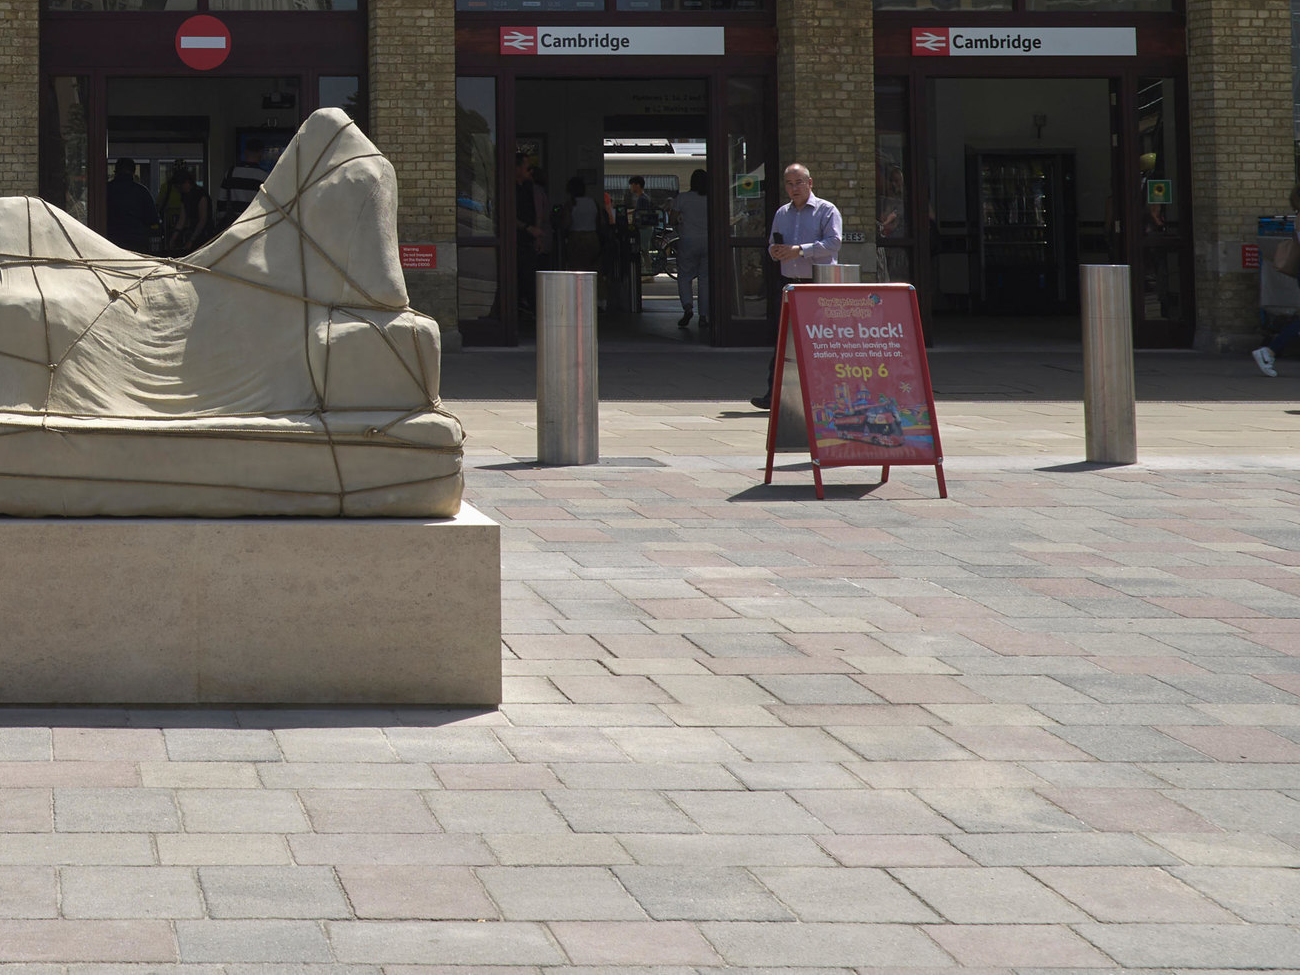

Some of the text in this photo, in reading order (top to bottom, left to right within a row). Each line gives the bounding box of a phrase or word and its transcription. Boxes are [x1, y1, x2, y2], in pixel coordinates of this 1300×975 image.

[541, 33, 630, 51] Cambridge
[953, 34, 1042, 52] Cambridge
[805, 322, 904, 339] We're back!
[812, 342, 828, 350] Turn
[829, 341, 841, 349] left
[862, 341, 888, 350] leaving
[813, 351, 839, 359] station,
[841, 351, 853, 359] you
[835, 363, 889, 381] Stop 6
